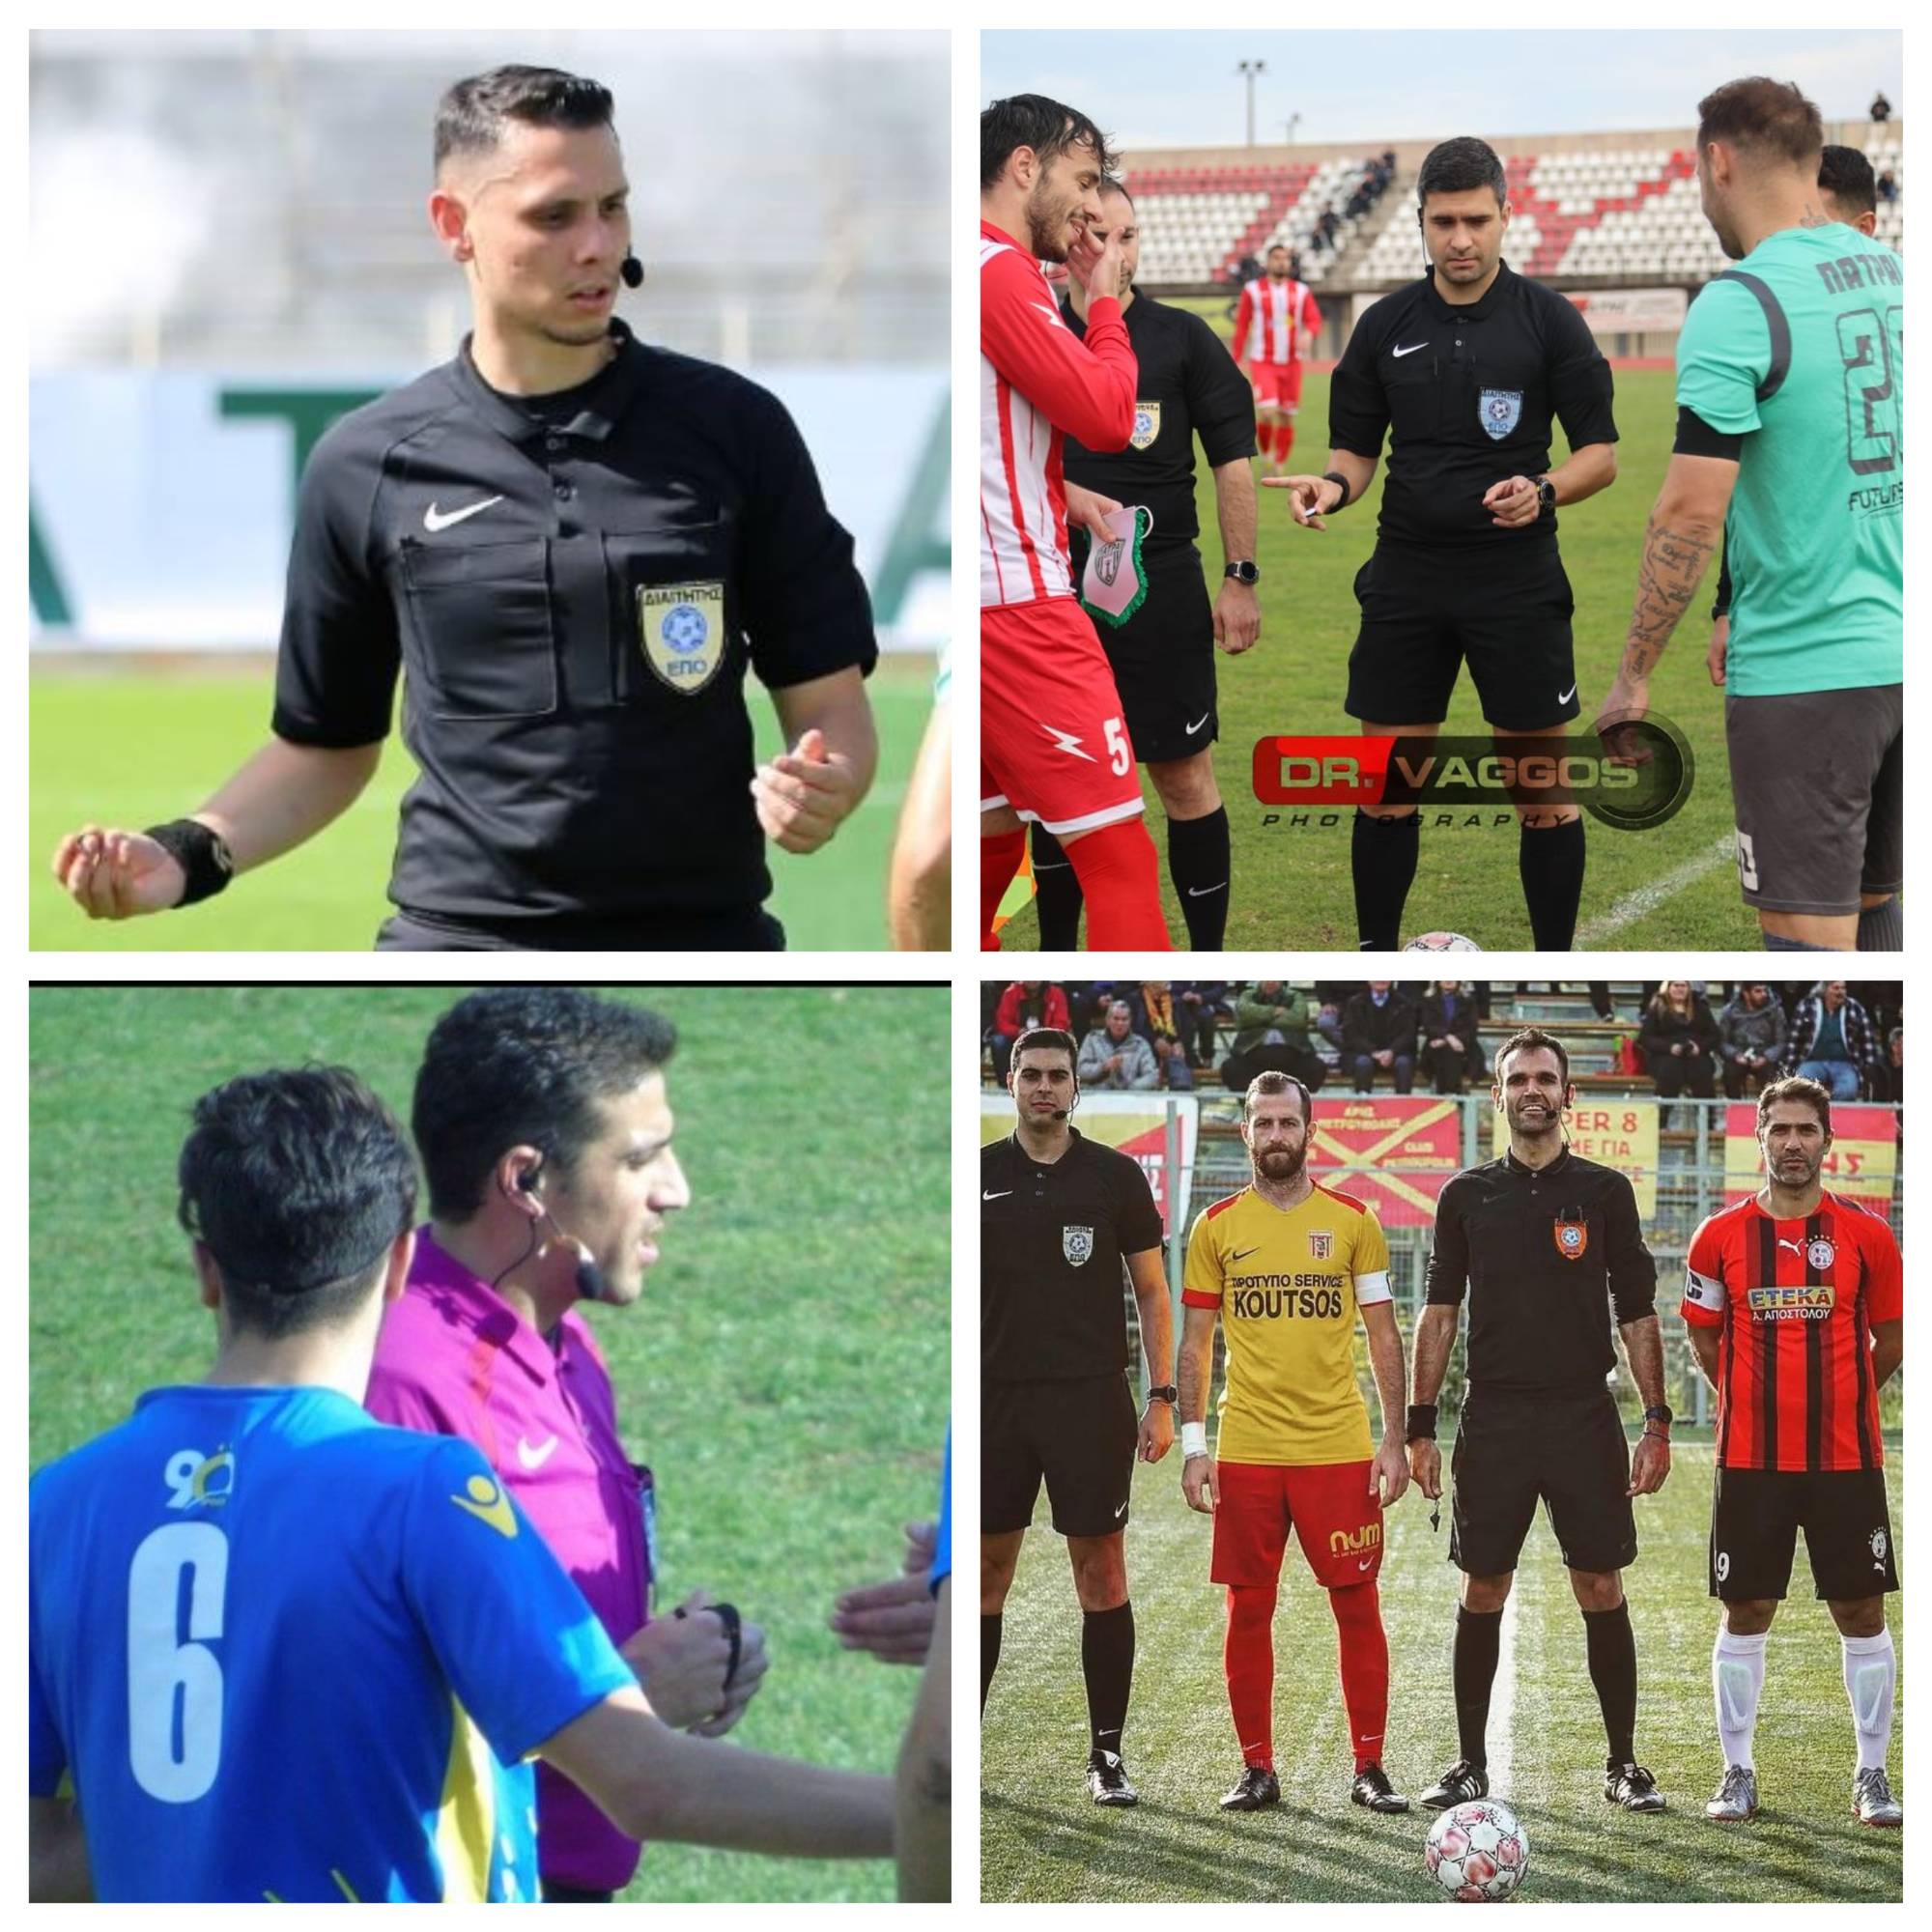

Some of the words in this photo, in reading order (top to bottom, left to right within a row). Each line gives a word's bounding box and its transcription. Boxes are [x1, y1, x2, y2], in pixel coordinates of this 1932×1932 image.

[1103, 717, 1129, 776] 5
[1622, 1112, 1638, 1133] 8
[1294, 1275, 1344, 1288] SERVICE
[1234, 1290, 1342, 1319] KOUTSOS
[1764, 1309, 1831, 1321] ΑΠΟΣΤΟΛΟΥ
[128, 1521, 229, 1804] 6
